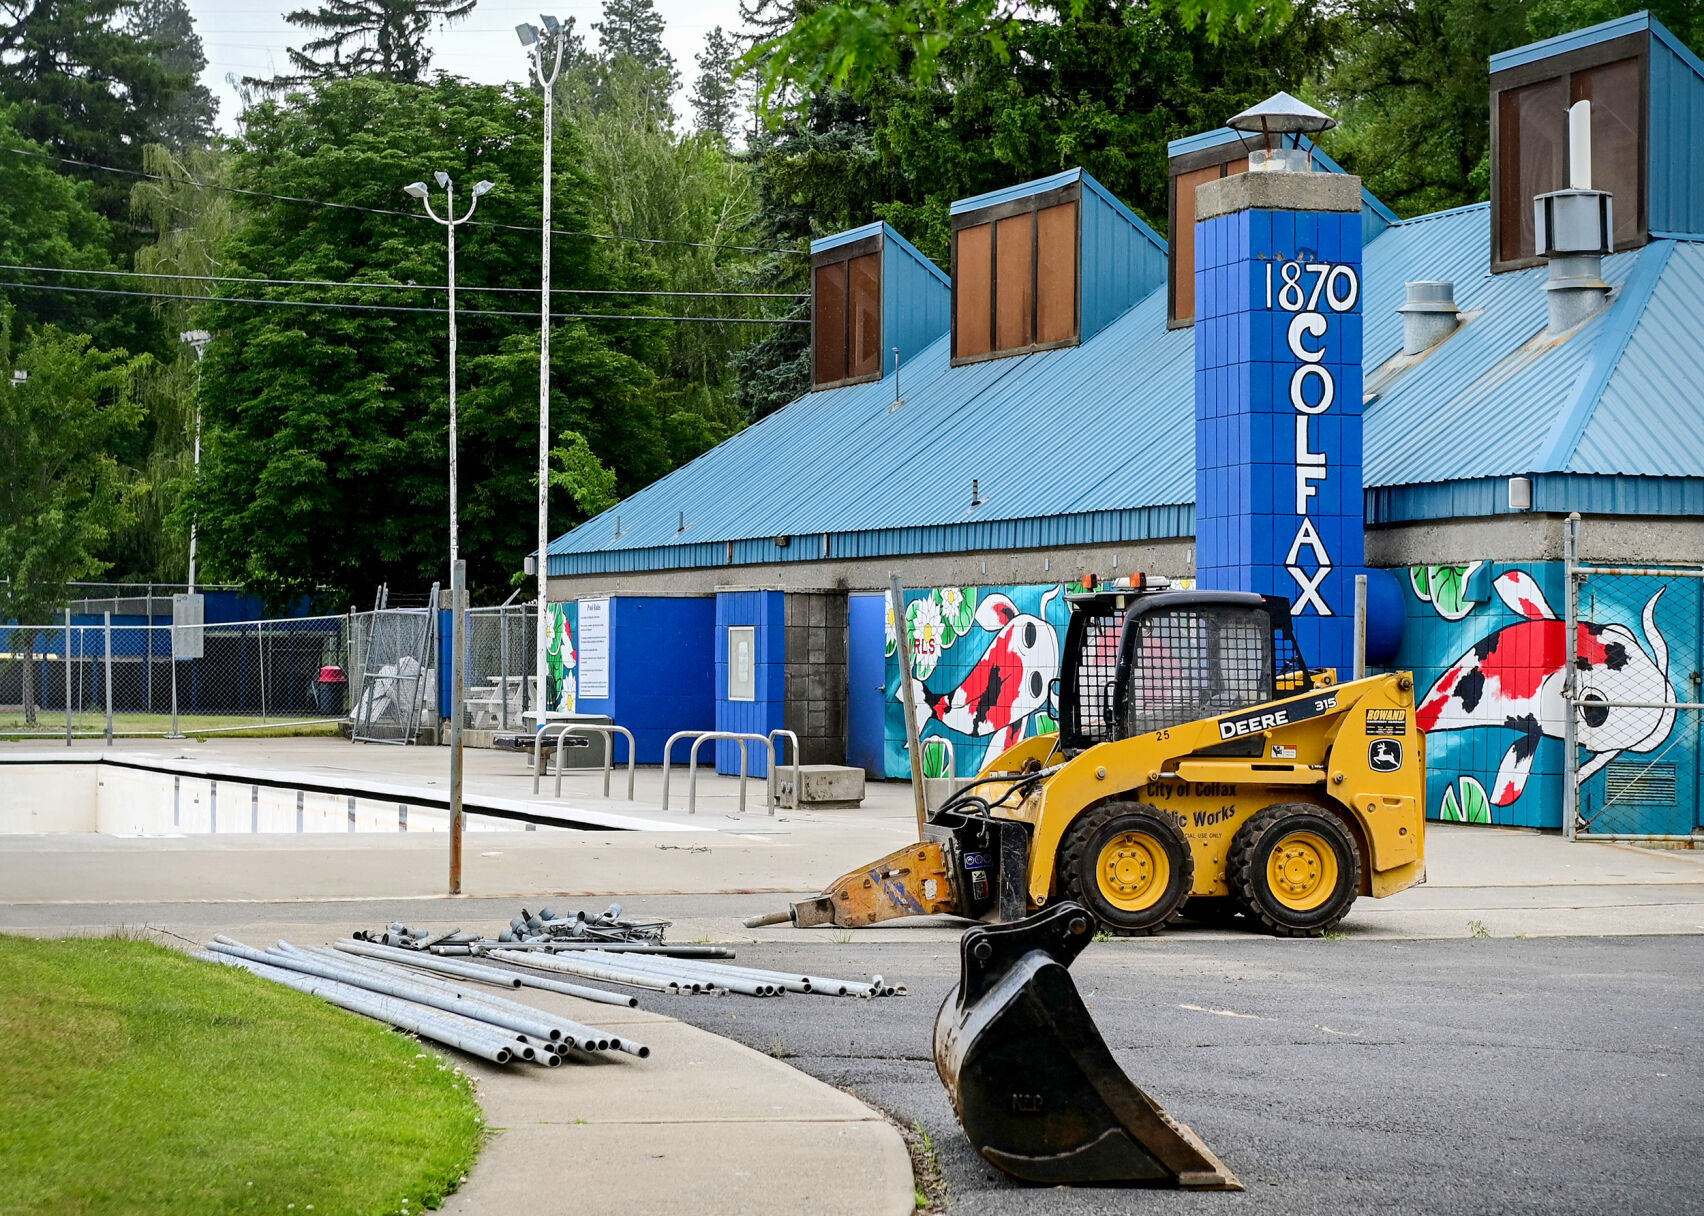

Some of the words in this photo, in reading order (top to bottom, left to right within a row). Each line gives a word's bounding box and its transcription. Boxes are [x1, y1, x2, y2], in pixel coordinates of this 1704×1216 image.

[1265, 262, 1359, 312] 1870
[1285, 312, 1336, 616] COLFAX
[908, 638, 936, 655] IRLS
[1314, 697, 1337, 712] 315
[1367, 709, 1406, 721] ROWAND
[1219, 710, 1289, 740] DEERE
[1156, 730, 1170, 742] 25
[1147, 781, 1173, 800] City
[1177, 781, 1190, 797] of
[1195, 781, 1237, 797] Colfax
[1193, 805, 1236, 828] Works
